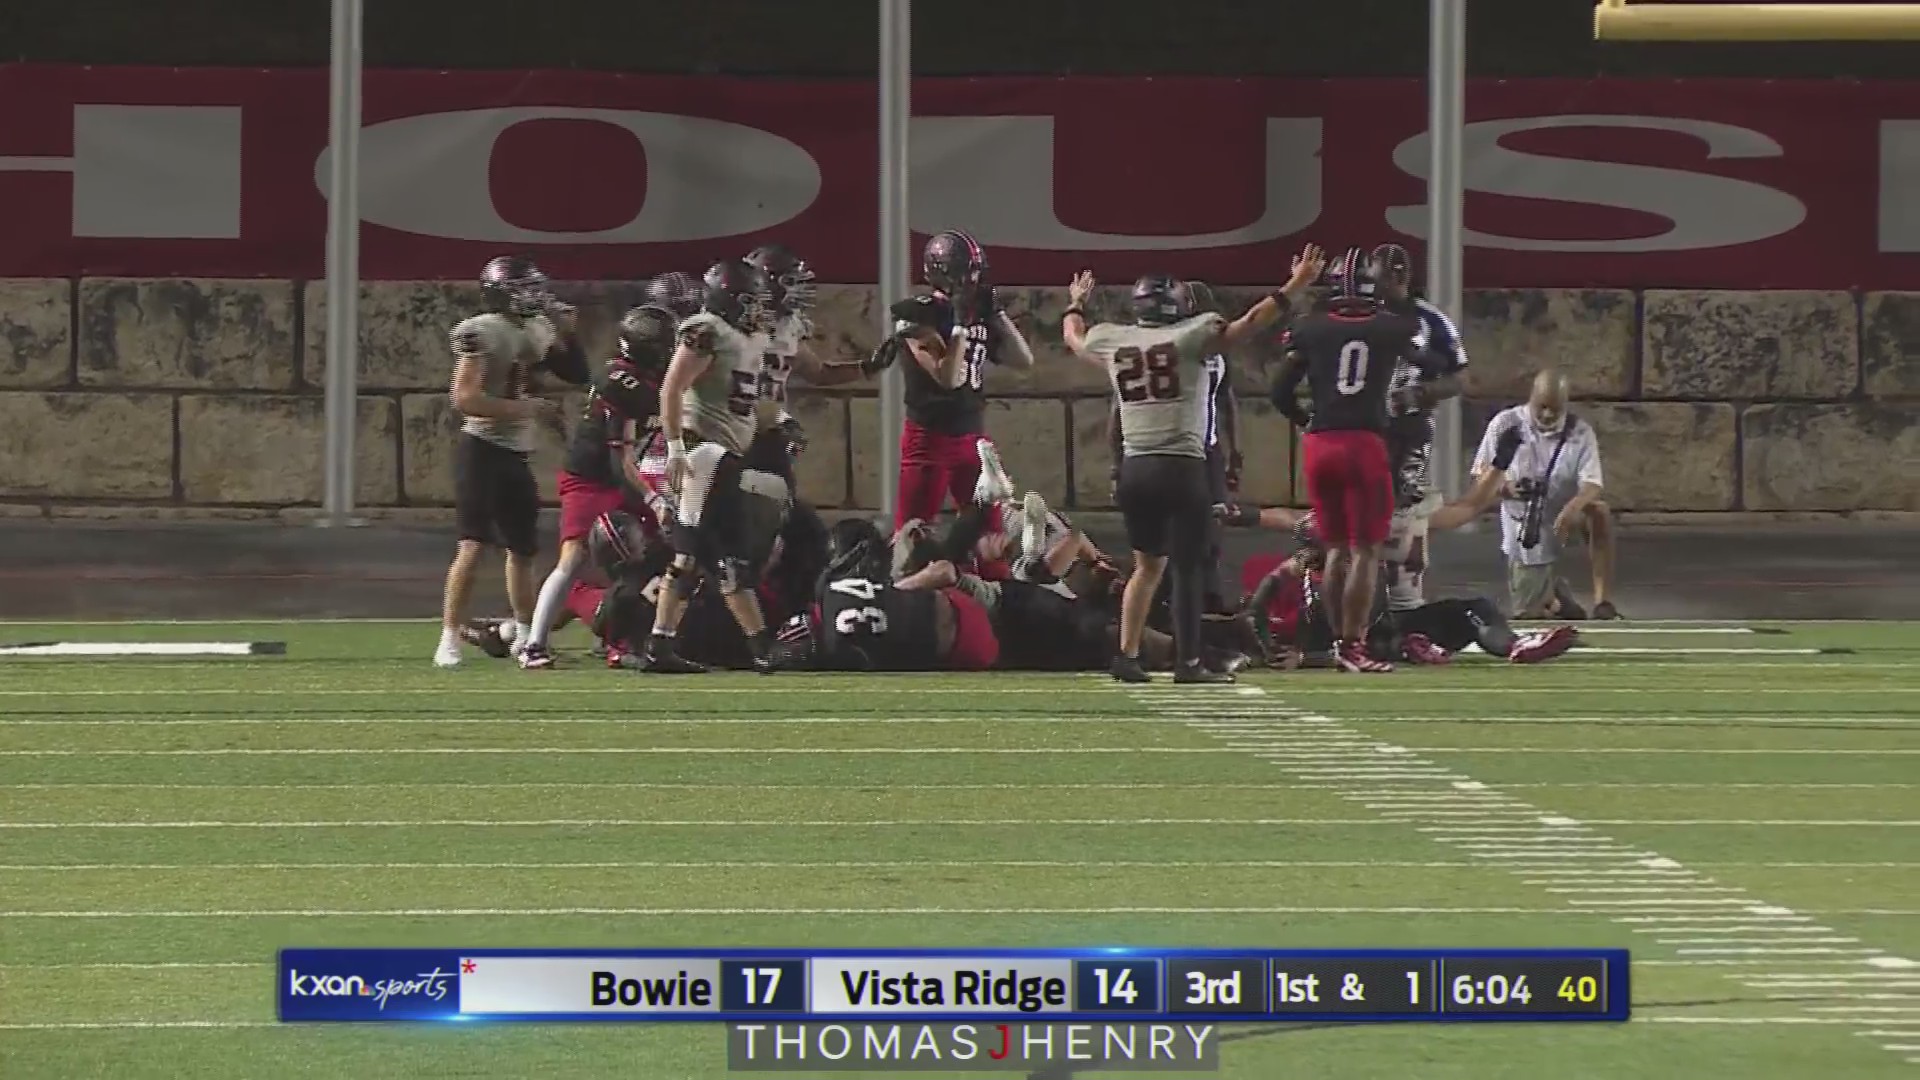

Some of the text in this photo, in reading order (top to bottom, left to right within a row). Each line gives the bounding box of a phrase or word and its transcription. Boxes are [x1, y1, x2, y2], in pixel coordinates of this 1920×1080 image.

[0, 103, 1920, 253] OUS
[1114, 342, 1180, 402] 28
[1336, 340, 1369, 395] 0
[829, 578, 888, 633] 34
